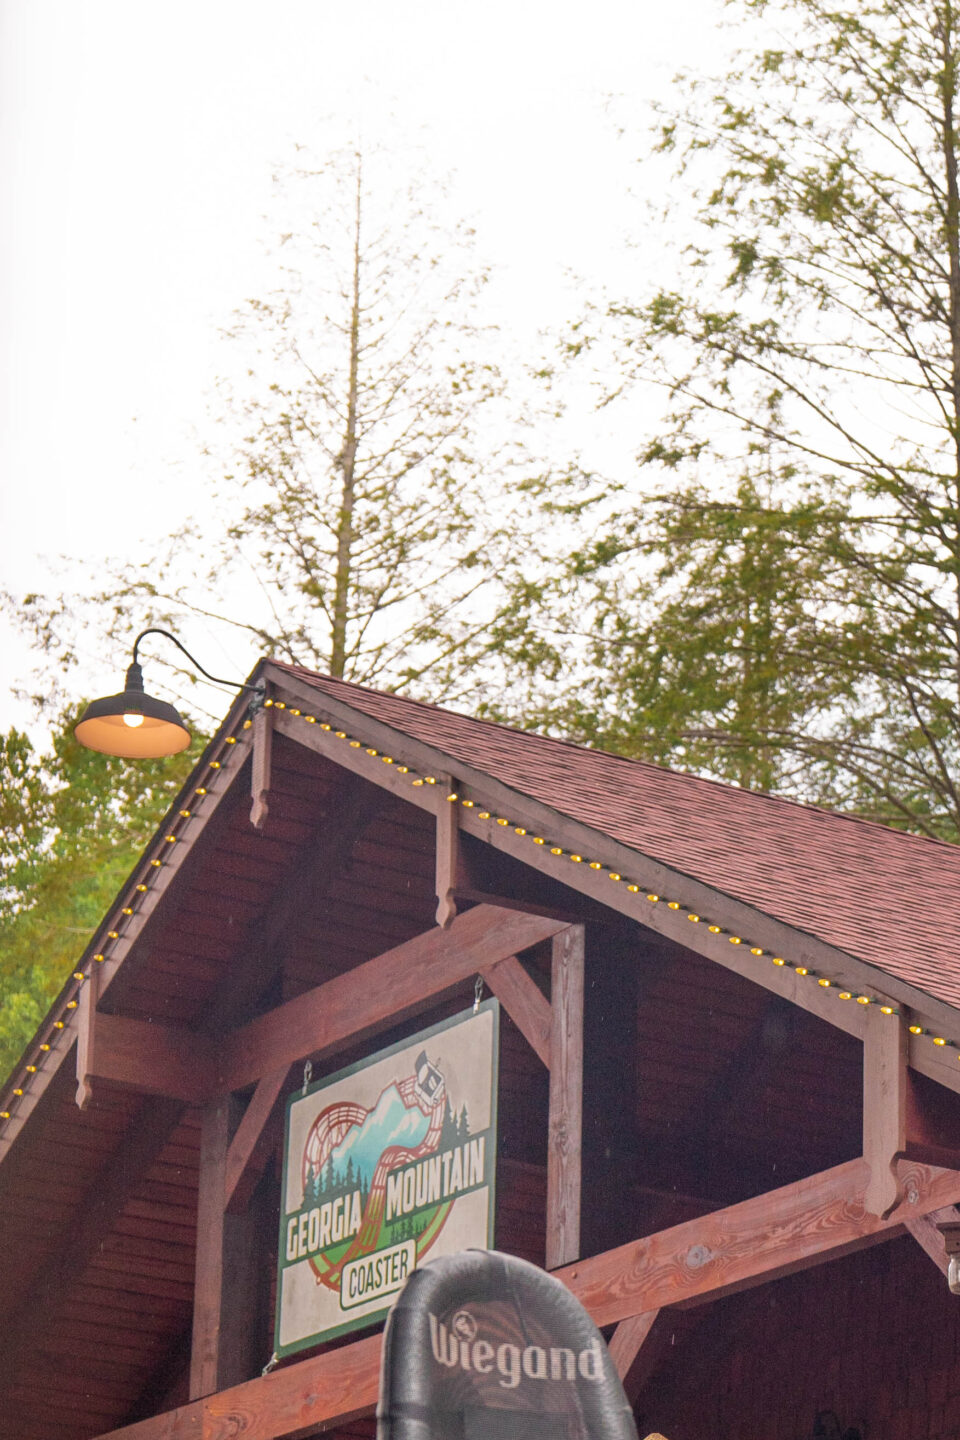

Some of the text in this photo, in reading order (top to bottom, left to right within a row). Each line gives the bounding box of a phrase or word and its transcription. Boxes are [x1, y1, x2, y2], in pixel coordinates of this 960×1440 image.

[386, 1136, 486, 1222] MOUNTAIN
[286, 1190, 363, 1262] GEORGIA
[349, 1248, 409, 1299] COASTER
[429, 1311, 606, 1389] Wiegand
